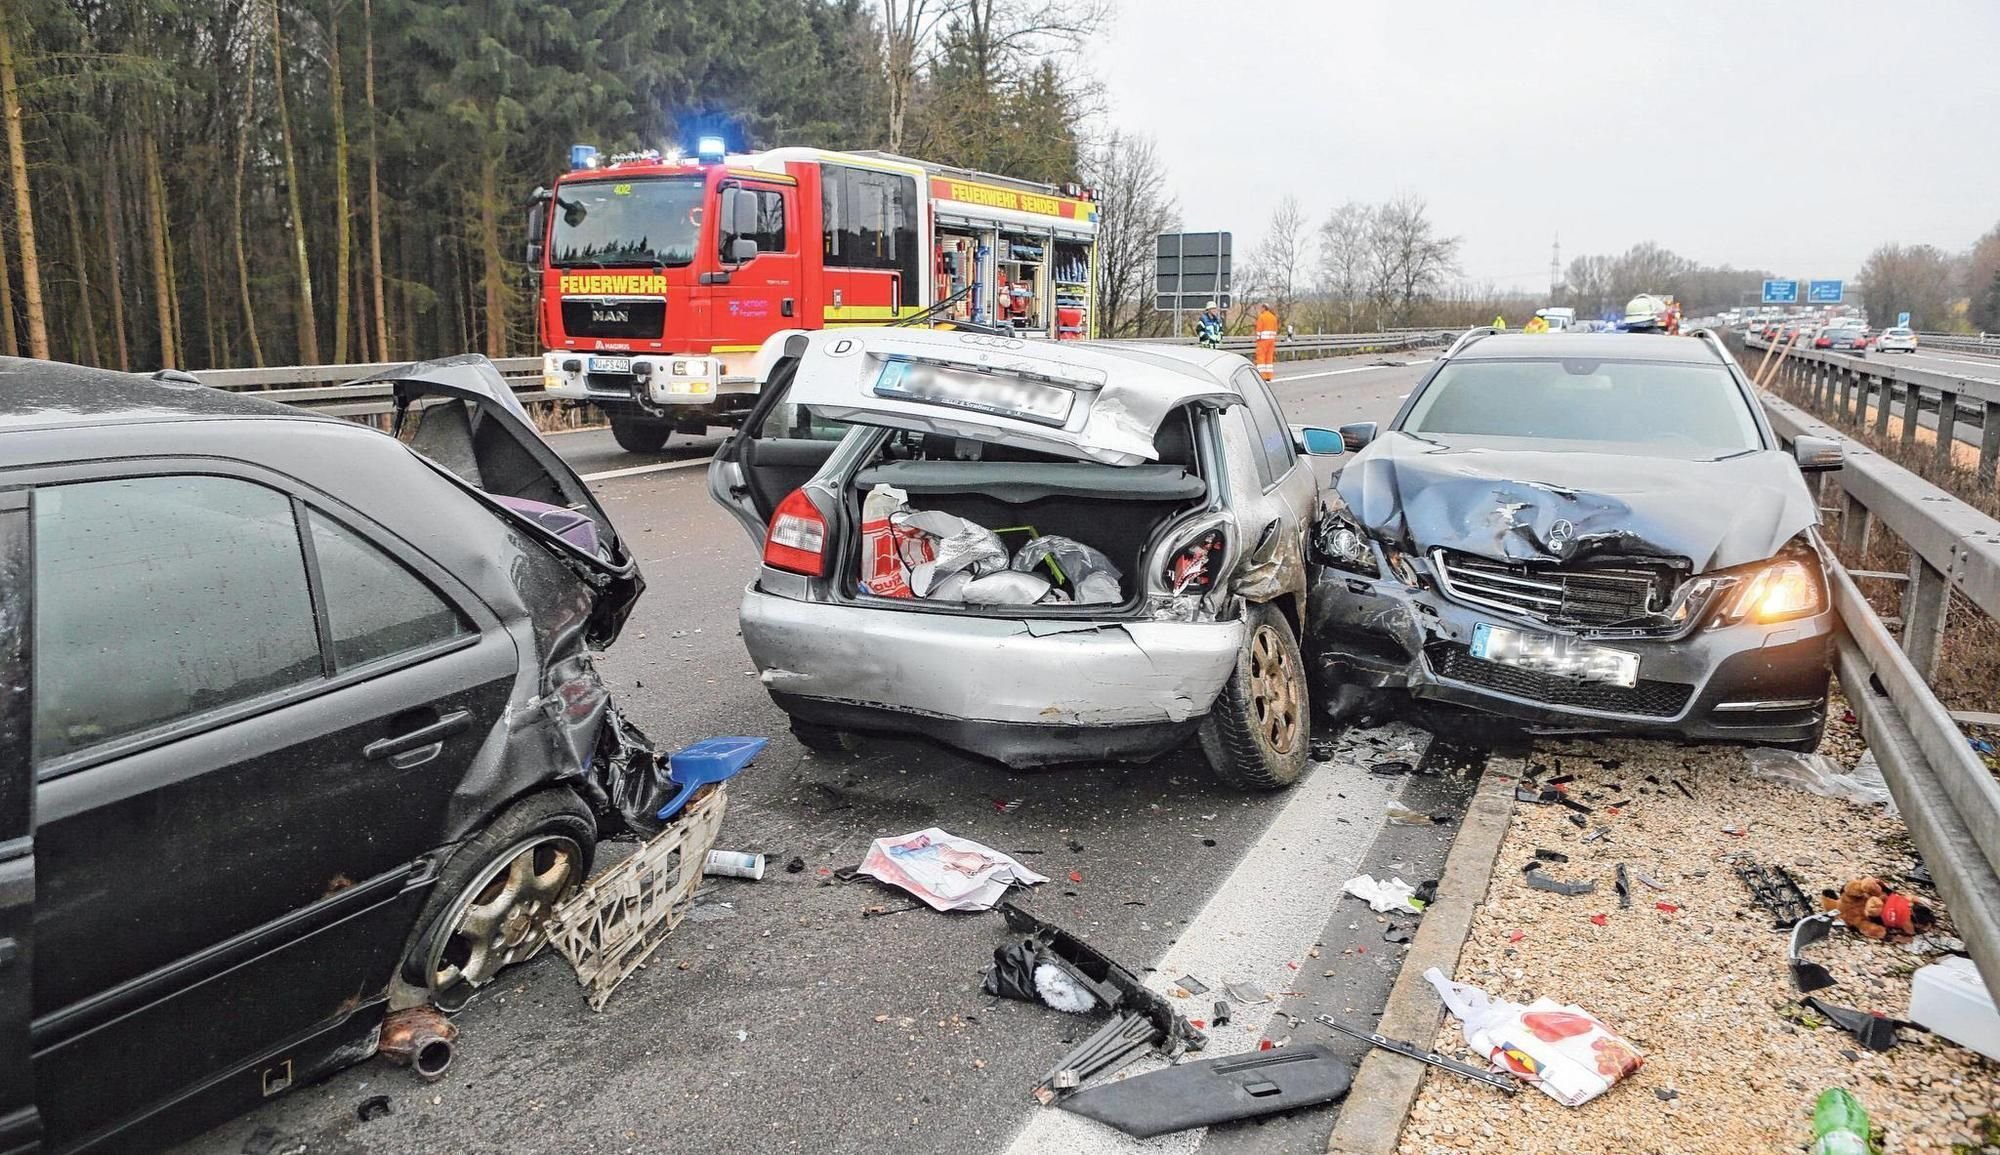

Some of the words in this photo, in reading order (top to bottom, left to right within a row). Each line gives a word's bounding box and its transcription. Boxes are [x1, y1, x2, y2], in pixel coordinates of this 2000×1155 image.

[614, 184, 631, 194] 402
[951, 183, 1017, 209] FEUERWEHR
[1020, 195, 1060, 216] SENDEN
[560, 275, 667, 293] FEUERWEHR
[592, 310, 629, 322] MAN
[834, 340, 852, 353] D
